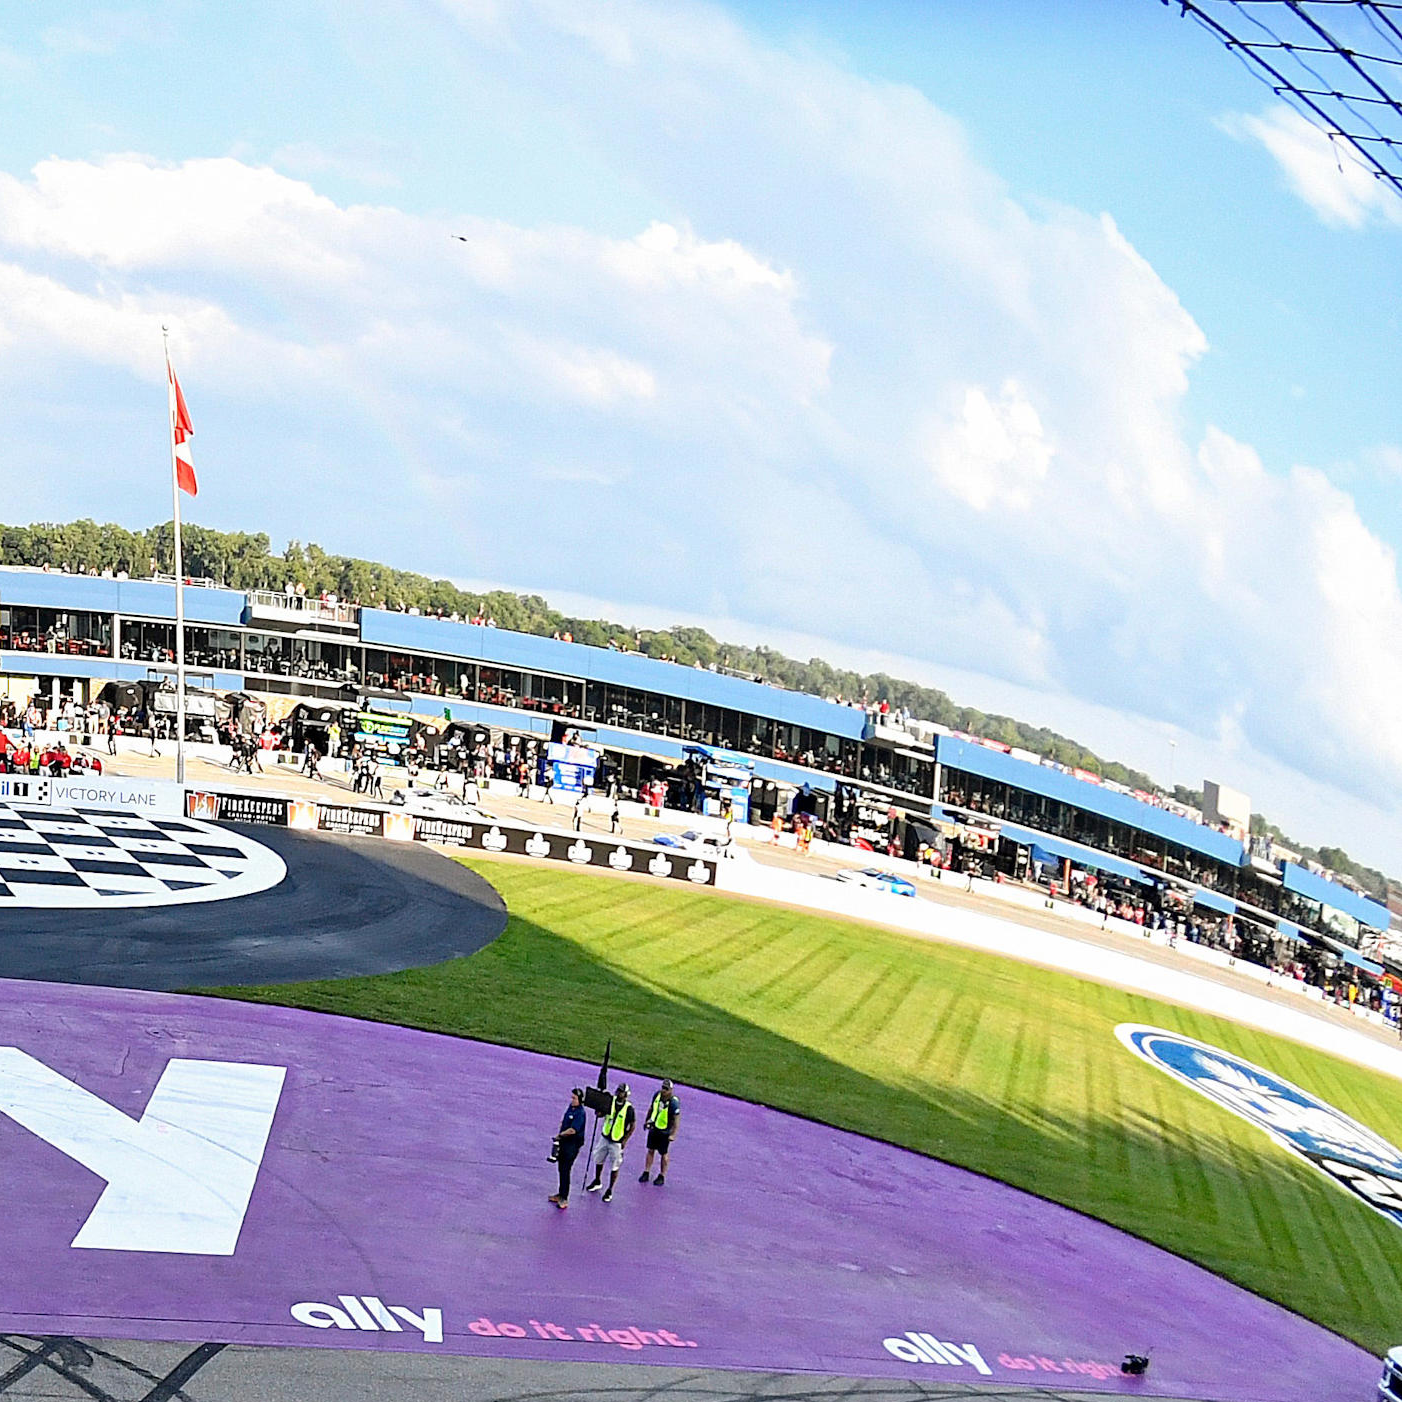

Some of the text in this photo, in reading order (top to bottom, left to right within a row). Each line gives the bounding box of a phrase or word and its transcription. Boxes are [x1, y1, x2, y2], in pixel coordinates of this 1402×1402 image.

[56, 787, 156, 806] VICTORY LANE
[221, 796, 283, 816] FIREKEEPERS
[320, 806, 381, 828] FIREKEEPERS
[290, 1295, 698, 1351] ally do it right.
[882, 1331, 993, 1376] ally
[997, 1352, 1036, 1372] do
[1038, 1356, 1065, 1374] it
